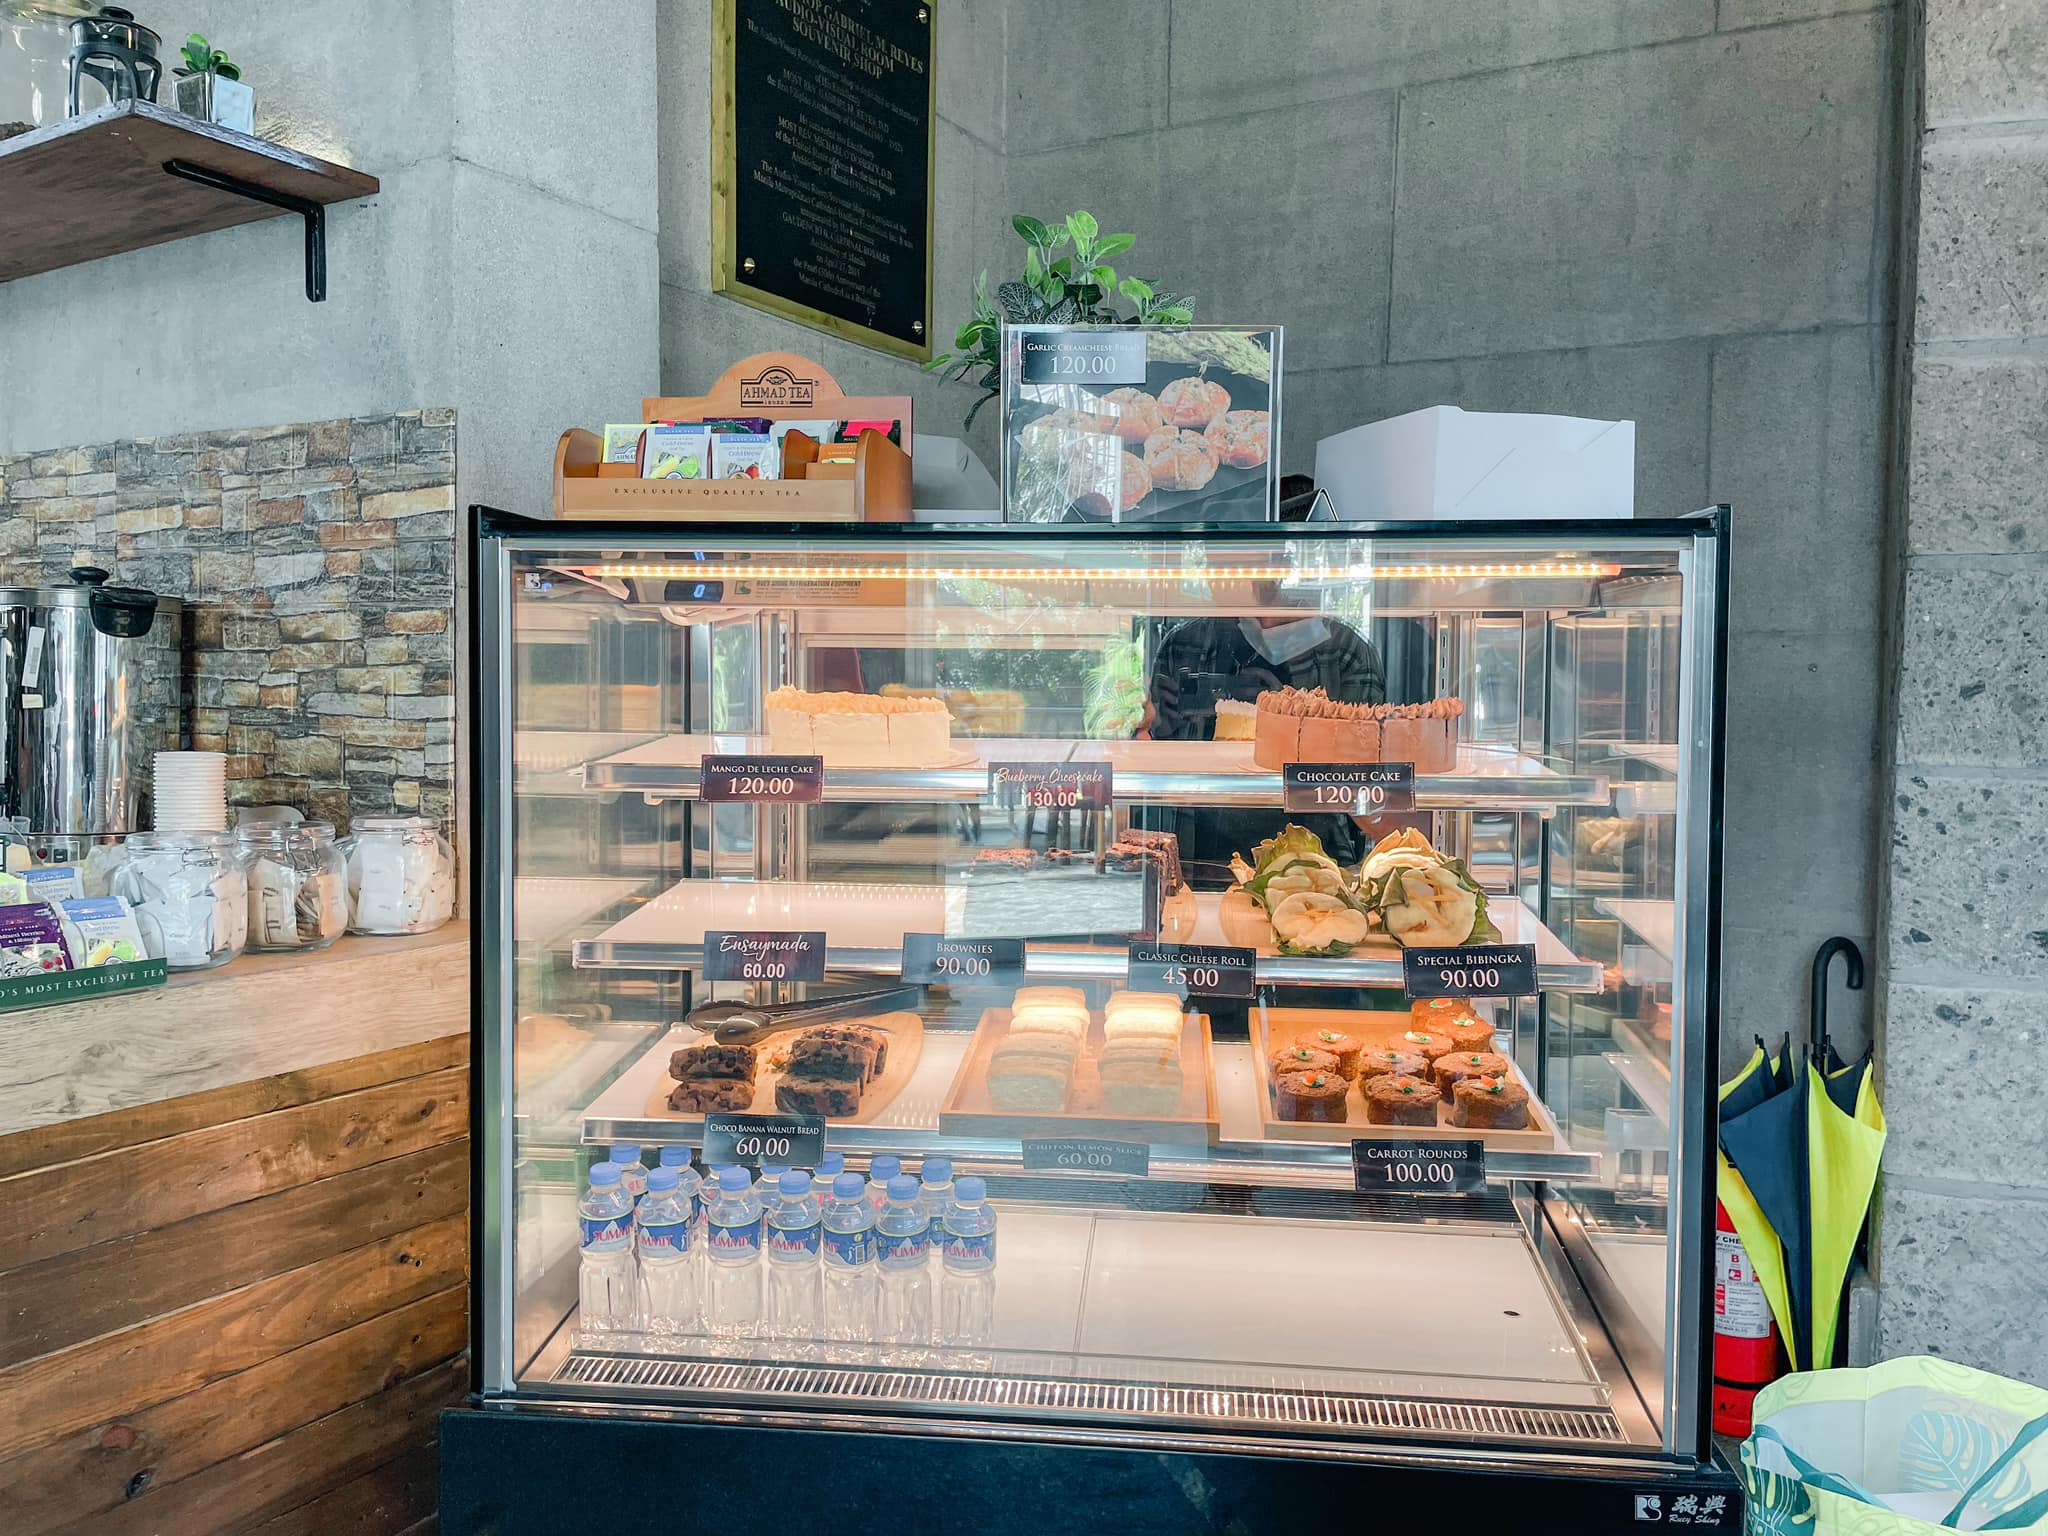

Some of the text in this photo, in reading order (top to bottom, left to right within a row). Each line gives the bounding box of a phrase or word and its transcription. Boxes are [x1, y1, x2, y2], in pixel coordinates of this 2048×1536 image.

[793, 16, 850, 62] SOUVENIR
[854, 53, 882, 79] SHOP
[824, 5, 873, 46] GABRIEL
[891, 44, 923, 74] REYES
[861, 43, 894, 72] ROOM
[1027, 343, 1056, 351] GARLIC
[1050, 355, 1116, 374] 120.00
[743, 387, 810, 398] AHMAD TEA
[711, 765, 745, 773] MANGO
[1297, 771, 1401, 782] CHOCOLATE CAKE
[728, 777, 794, 795] 120.00
[997, 768, 1104, 791] Blueberry Cheesecake
[1026, 792, 1077, 807] 130.00
[1314, 786, 1384, 804] 120.00
[720, 935, 810, 961] Ensaymada
[936, 943, 993, 953] BROWNIES
[936, 957, 990, 976] 90.00
[1138, 952, 1247, 966] CLASSIC CHEESE ROLL
[1417, 954, 1522, 966] SPECIAL BIBINGKA
[743, 963, 785, 978] 60.00
[1162, 967, 1219, 987] 45.00
[1440, 969, 1499, 989] 90.00
[25, 982, 61, 994] MOST
[67, 973, 136, 989] EXCLUSIVE
[142, 969, 165, 978] TEA
[710, 1123, 819, 1135] CHOCO BANANA WALNUT BREAD
[736, 1137, 790, 1157] 60.00
[1367, 1148, 1468, 1158] CARROT ROUNDS
[1057, 1153, 1112, 1166] 60.00
[1384, 1163, 1454, 1182] 100.00
